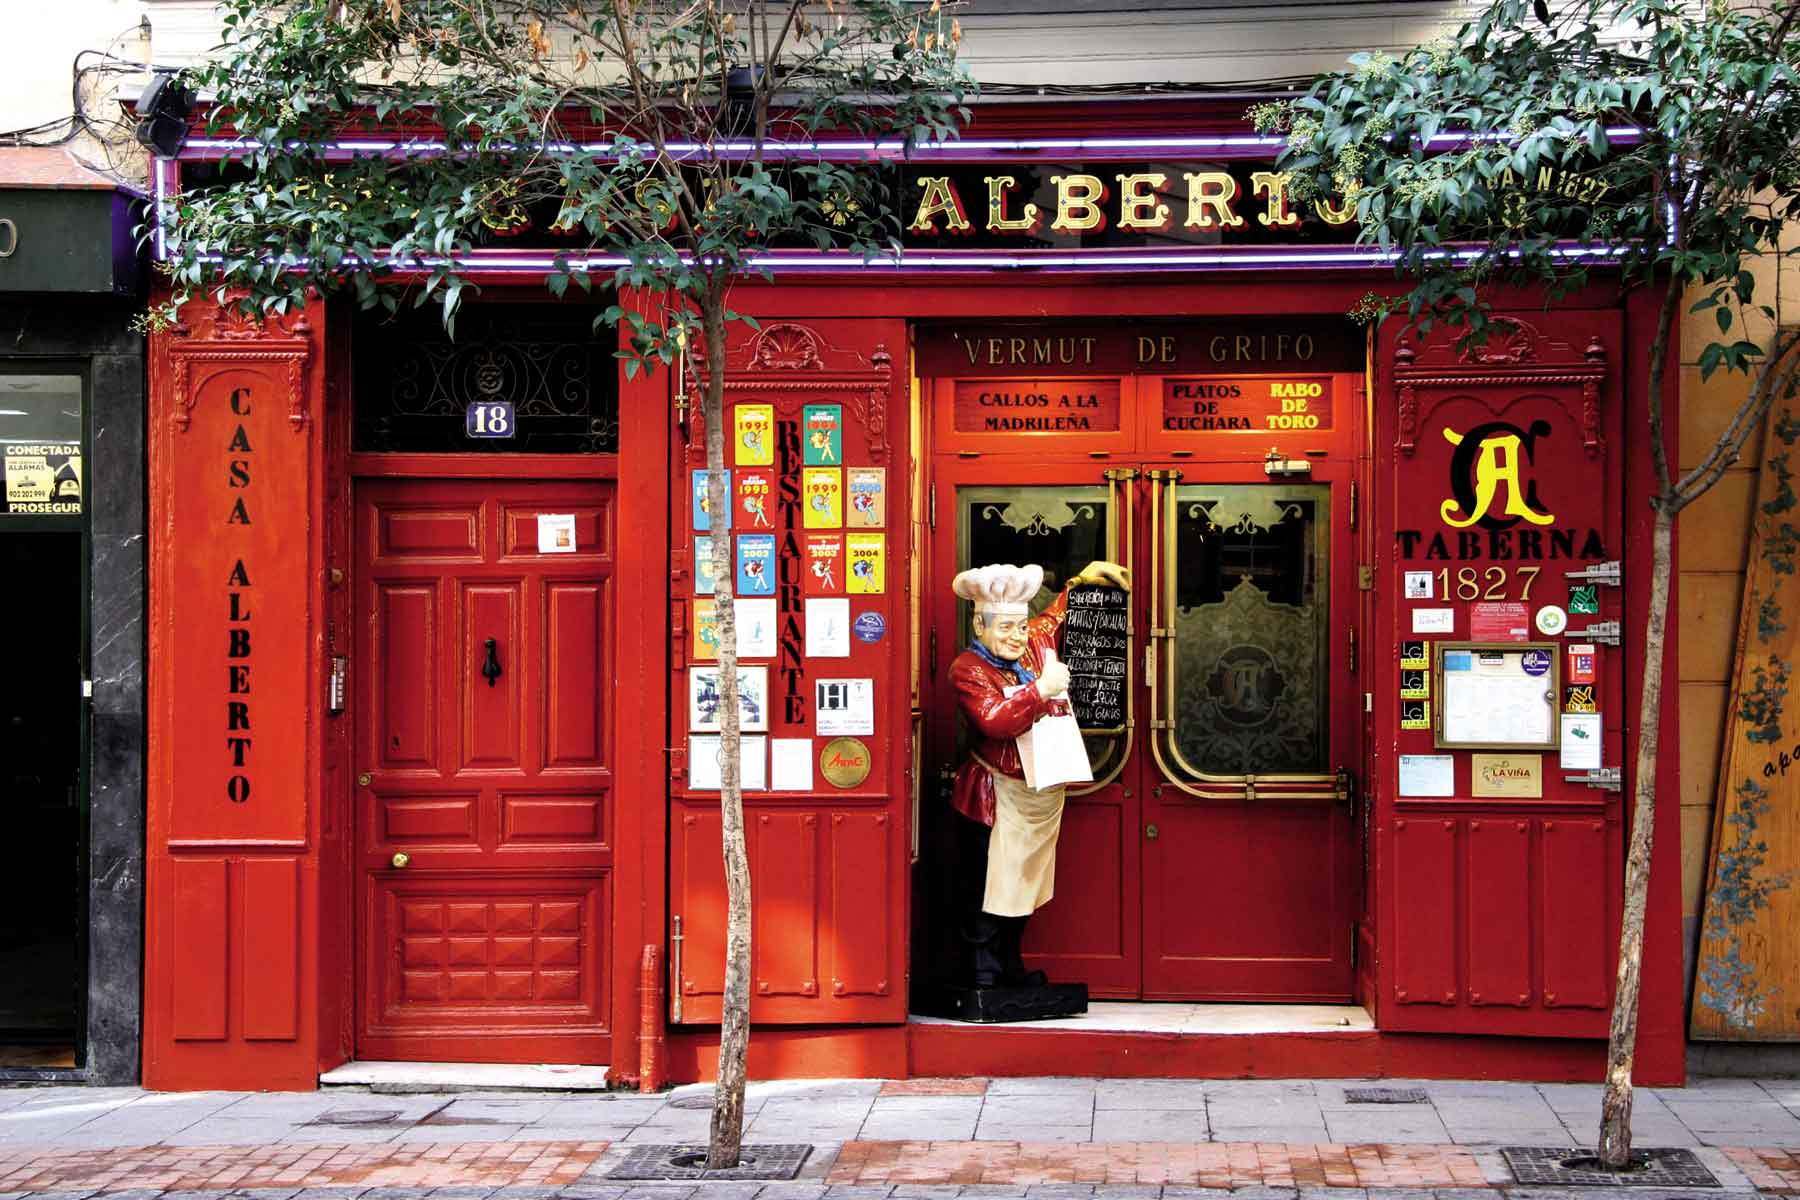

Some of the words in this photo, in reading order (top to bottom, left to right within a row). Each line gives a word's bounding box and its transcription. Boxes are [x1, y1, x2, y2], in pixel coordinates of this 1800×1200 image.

[963, 337, 1097, 365] VERMUT
[1137, 336, 1177, 363] DE
[1208, 334, 1314, 361] GRIFO
[1172, 384, 1241, 399] PLATOS
[1270, 382, 1322, 398] RABO
[979, 393, 1049, 408] CALLOS
[1060, 394, 1071, 408] A
[1077, 394, 1099, 408] LA
[1194, 401, 1219, 416] DE
[1281, 399, 1307, 414] DE
[474, 406, 508, 433] 18
[984, 413, 1090, 431] MADRILEÑA
[1164, 416, 1252, 431] CUCHARA
[1265, 414, 1319, 430] TORO
[6, 446, 80, 456] CONECTADA
[227, 387, 253, 525] CASA
[9, 503, 81, 513] PROSEGUR
[1396, 528, 1606, 561] TABERNA
[776, 420, 805, 724] RESTAURANTE
[1437, 566, 1541, 601] 1827
[227, 559, 253, 804] ALBERTO
[1491, 768, 1506, 777] LA
[1507, 766, 1531, 777] VIÑA
